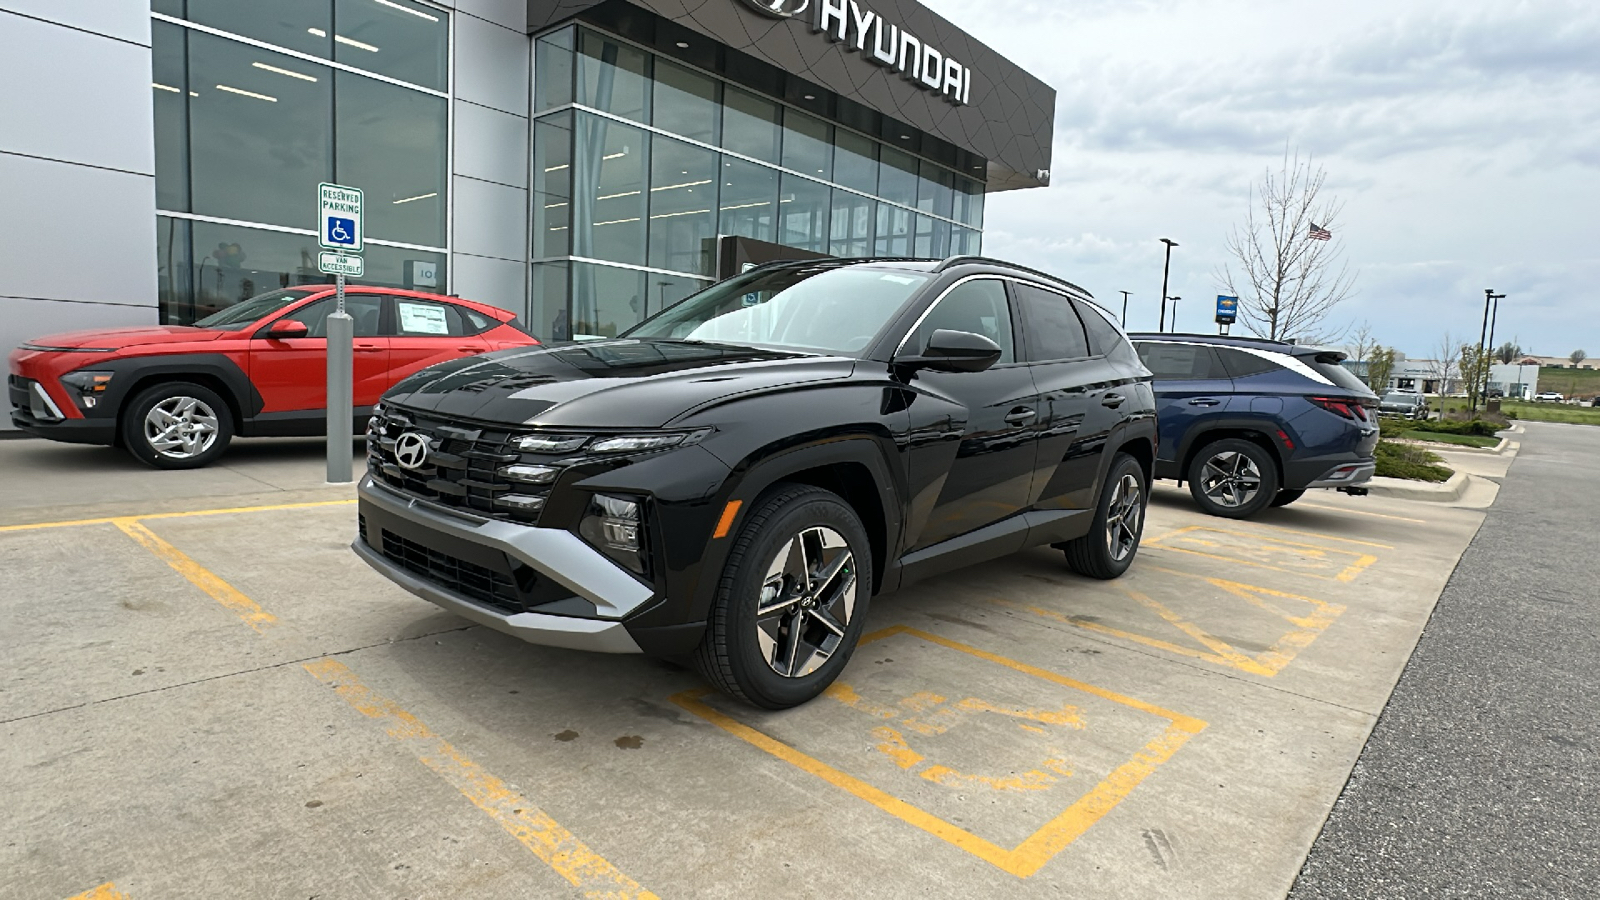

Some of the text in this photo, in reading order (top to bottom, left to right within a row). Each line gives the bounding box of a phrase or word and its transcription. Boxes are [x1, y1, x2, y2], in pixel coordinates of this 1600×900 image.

[820, 0, 971, 104] HYUNDAI
[323, 189, 359, 203] RESERVED
[323, 201, 359, 214] PARKING
[322, 262, 360, 273] ACCESSIBLE
